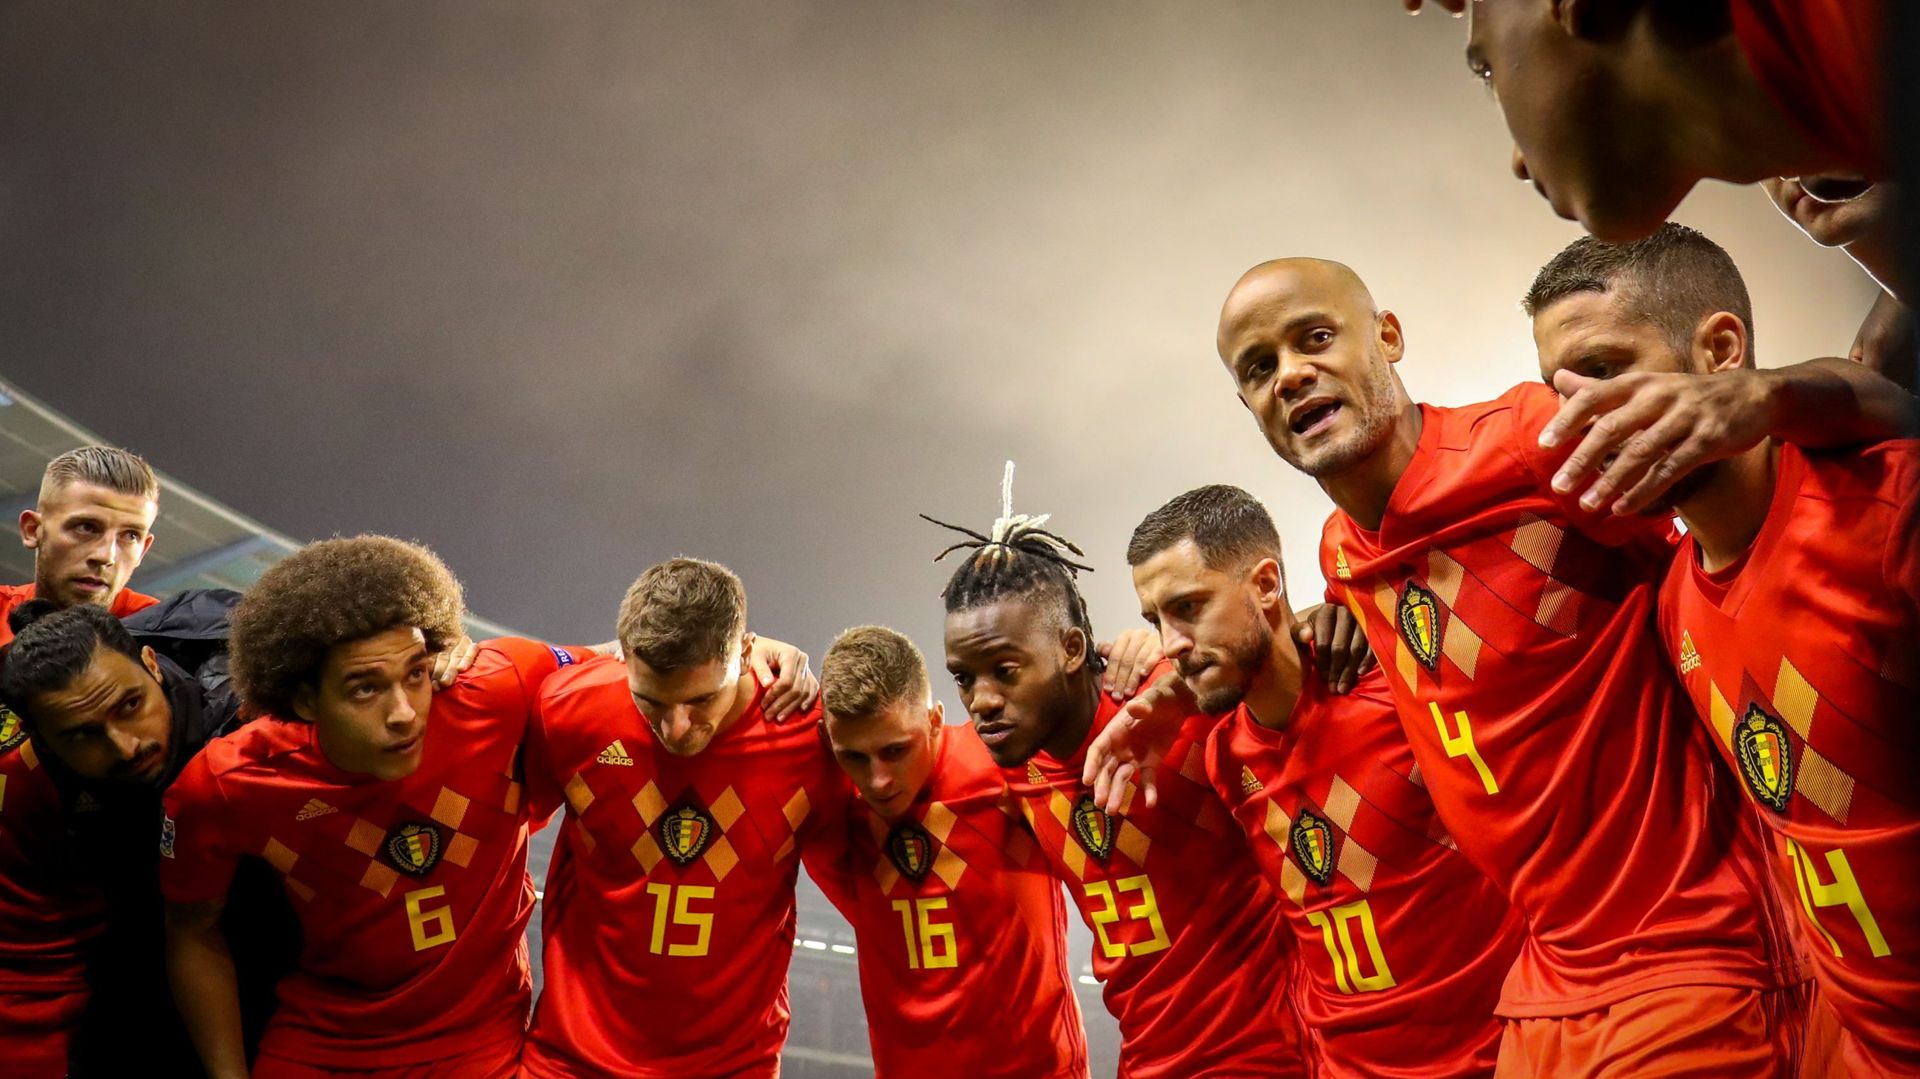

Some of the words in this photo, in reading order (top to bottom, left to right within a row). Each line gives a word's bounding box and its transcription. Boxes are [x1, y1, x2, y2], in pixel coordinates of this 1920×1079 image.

[597, 755, 634, 767] adidas
[1428, 701, 1499, 795] 4
[295, 806, 339, 821] adidas
[405, 886, 456, 952] 6
[646, 882, 714, 957] 15
[892, 897, 958, 970] 16
[1084, 874, 1172, 958] 23
[1786, 837, 1891, 958] 14
[1307, 899, 1397, 994] 10
